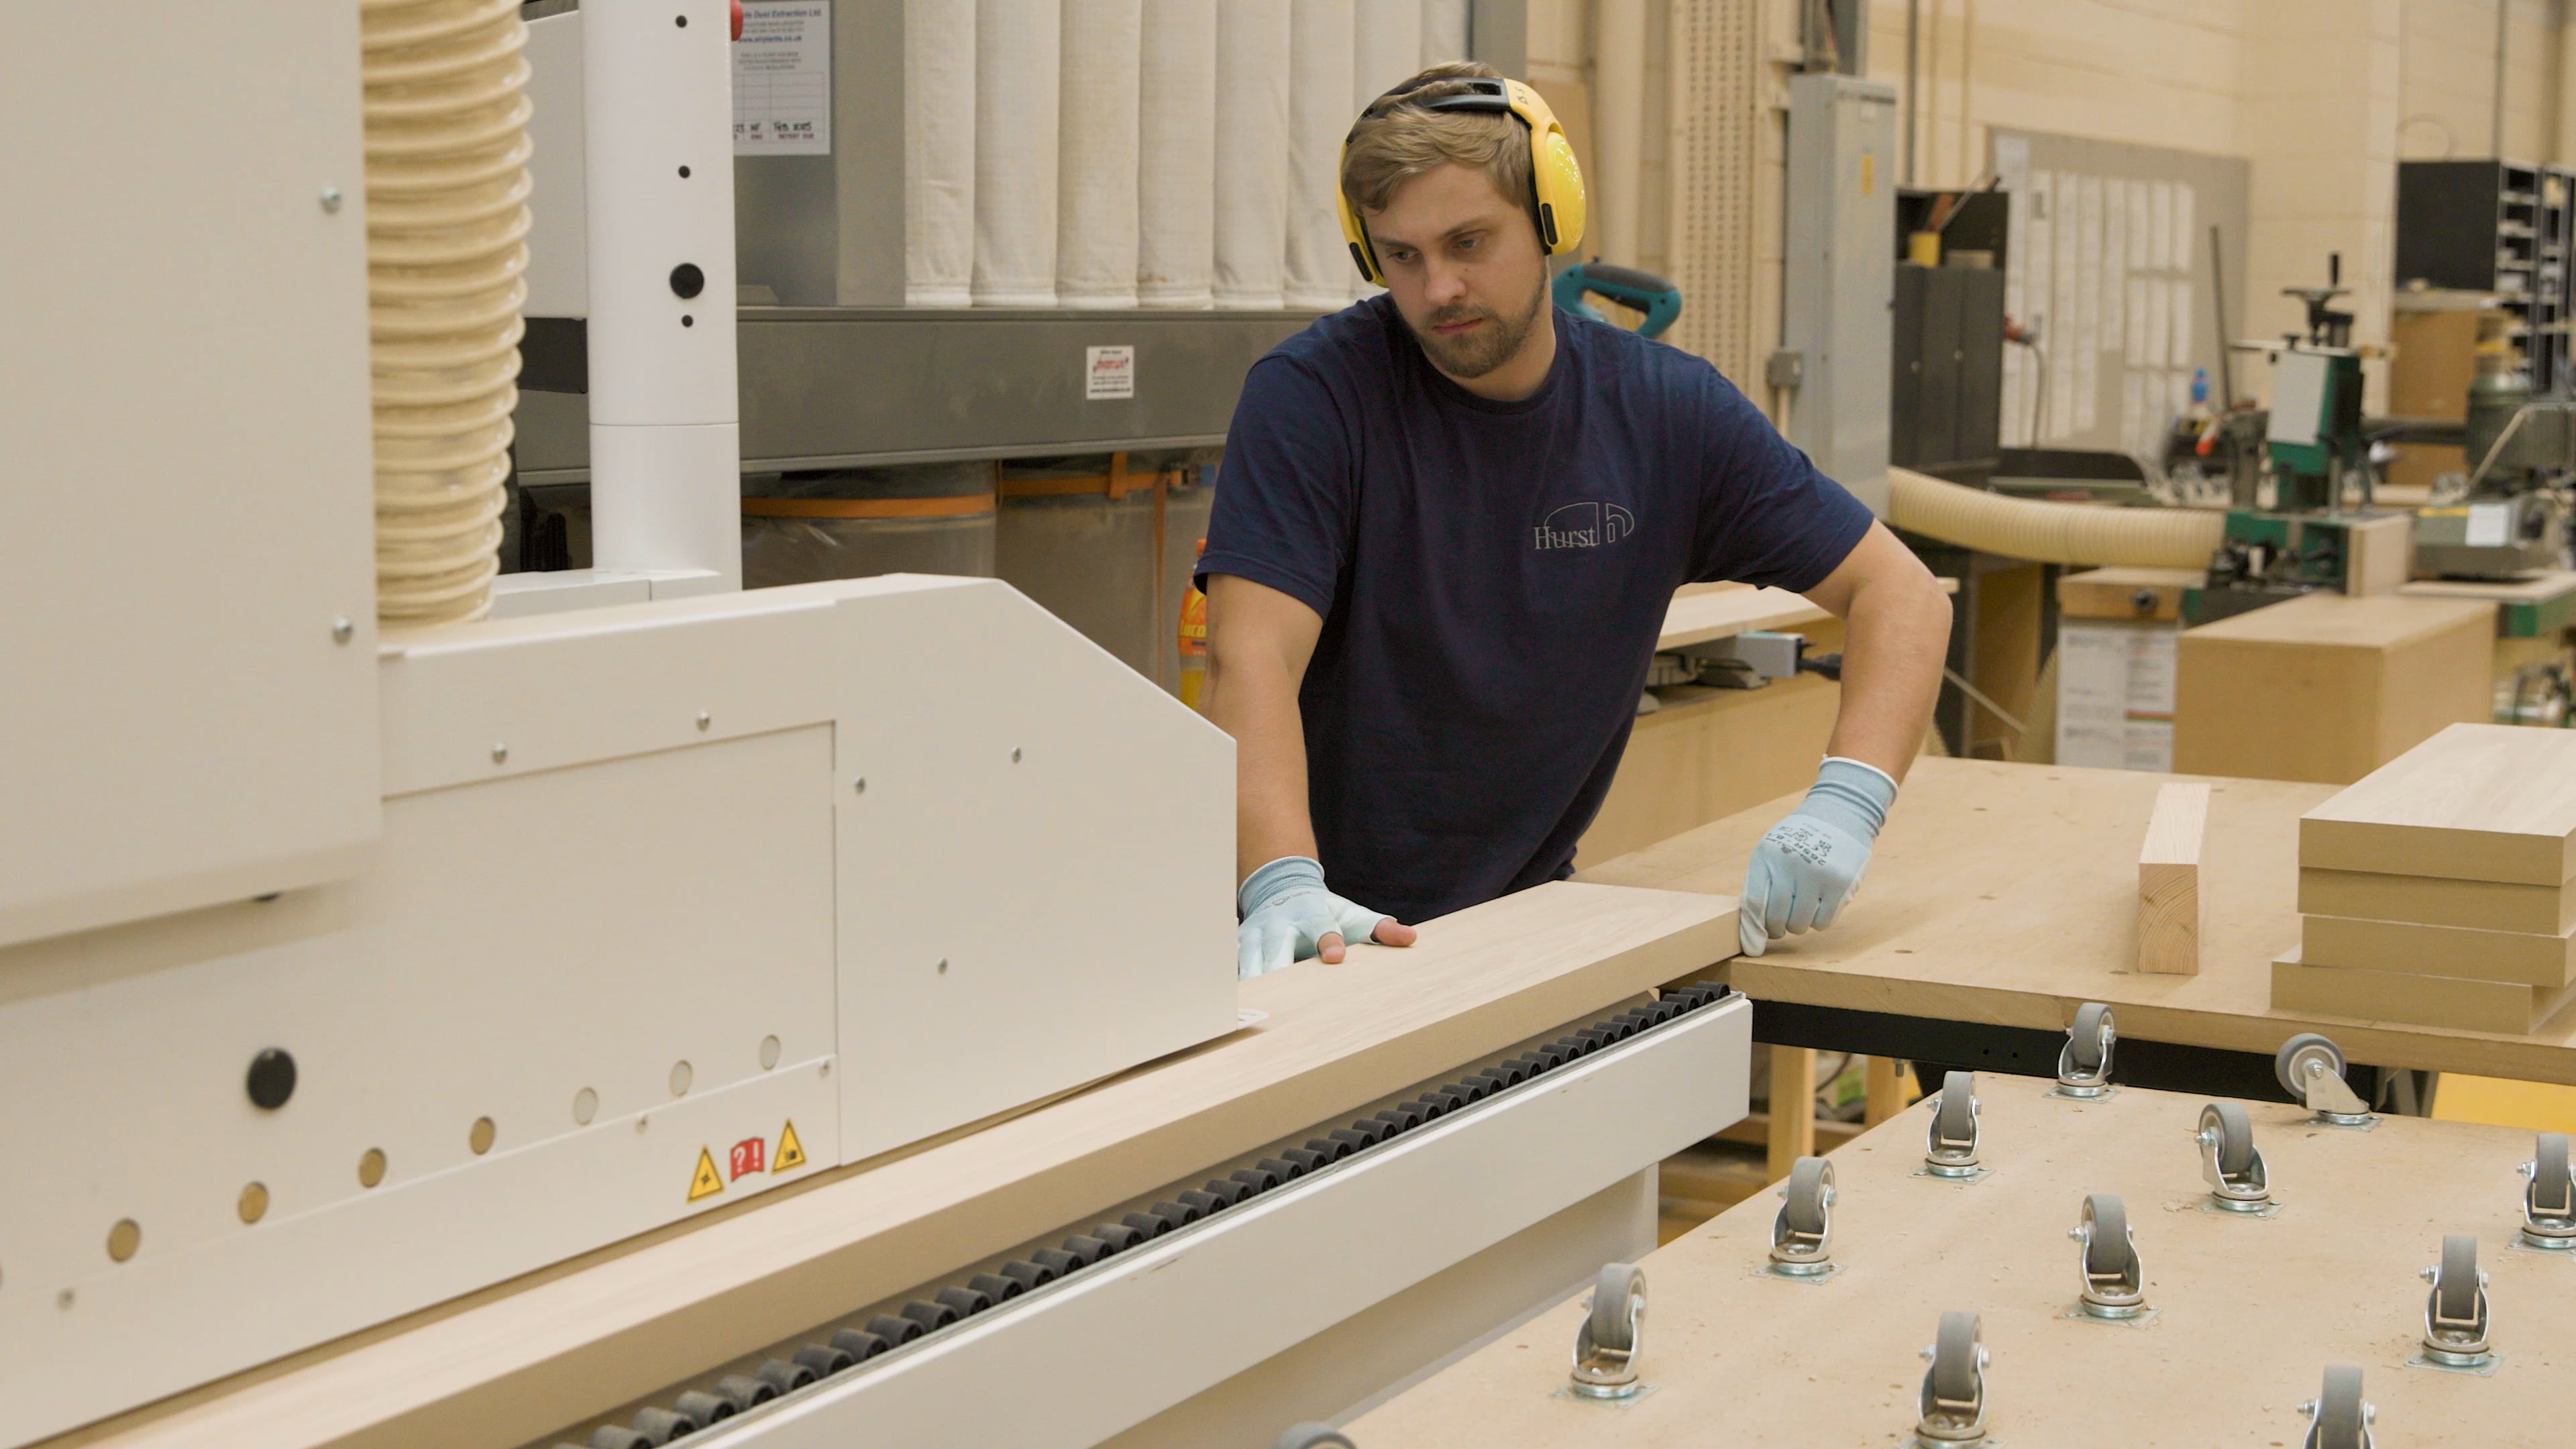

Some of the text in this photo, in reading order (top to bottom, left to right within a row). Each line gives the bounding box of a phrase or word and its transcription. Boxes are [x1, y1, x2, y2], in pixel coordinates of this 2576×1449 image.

[772, 8, 807, 18] Extraction
[1534, 526, 1596, 549] Hurst
[1180, 621, 1207, 639] Luco
